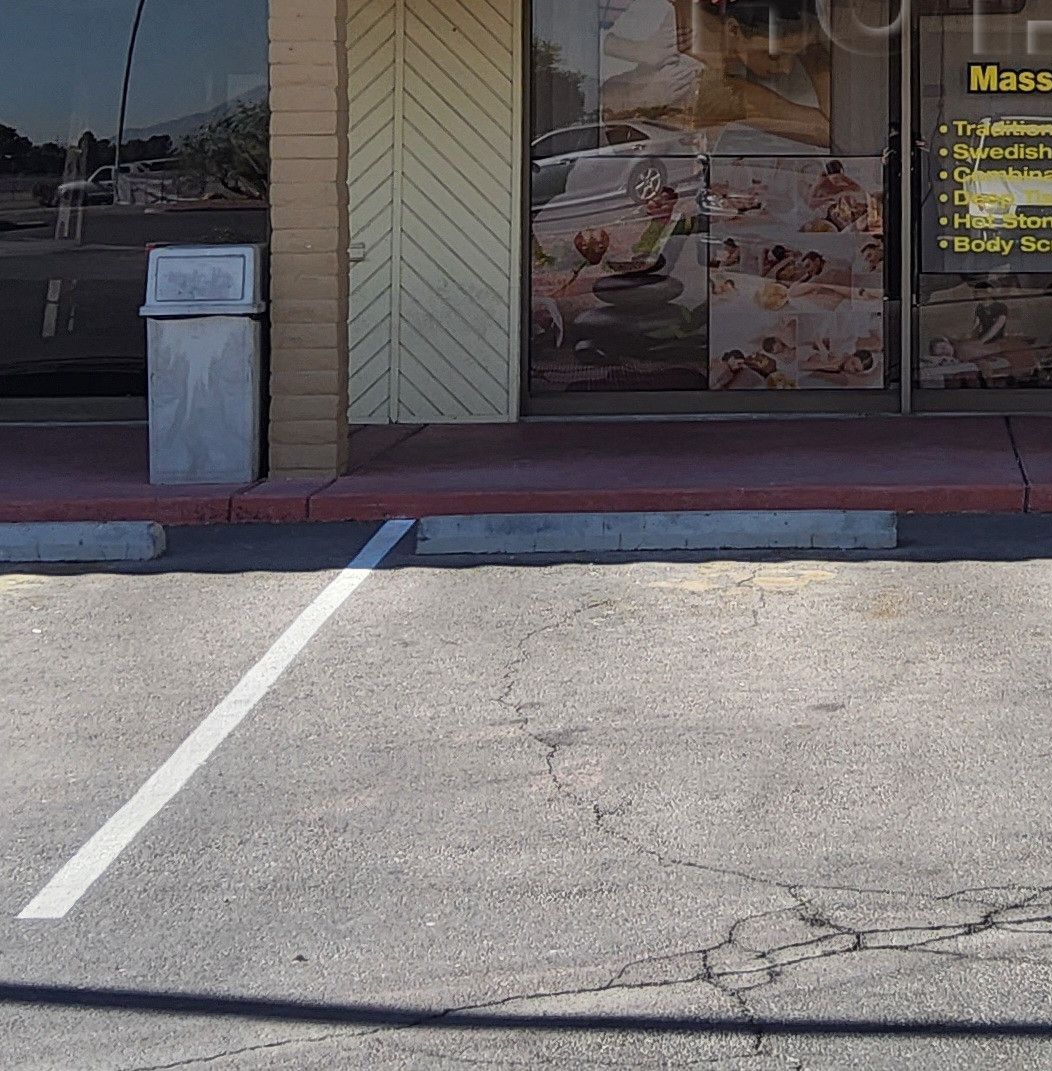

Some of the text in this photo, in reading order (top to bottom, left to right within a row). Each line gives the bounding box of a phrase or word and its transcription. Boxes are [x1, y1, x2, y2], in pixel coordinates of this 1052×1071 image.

[953, 143, 1052, 160] Swedish
[953, 213, 996, 228] Hot
[953, 235, 1014, 254] Body
